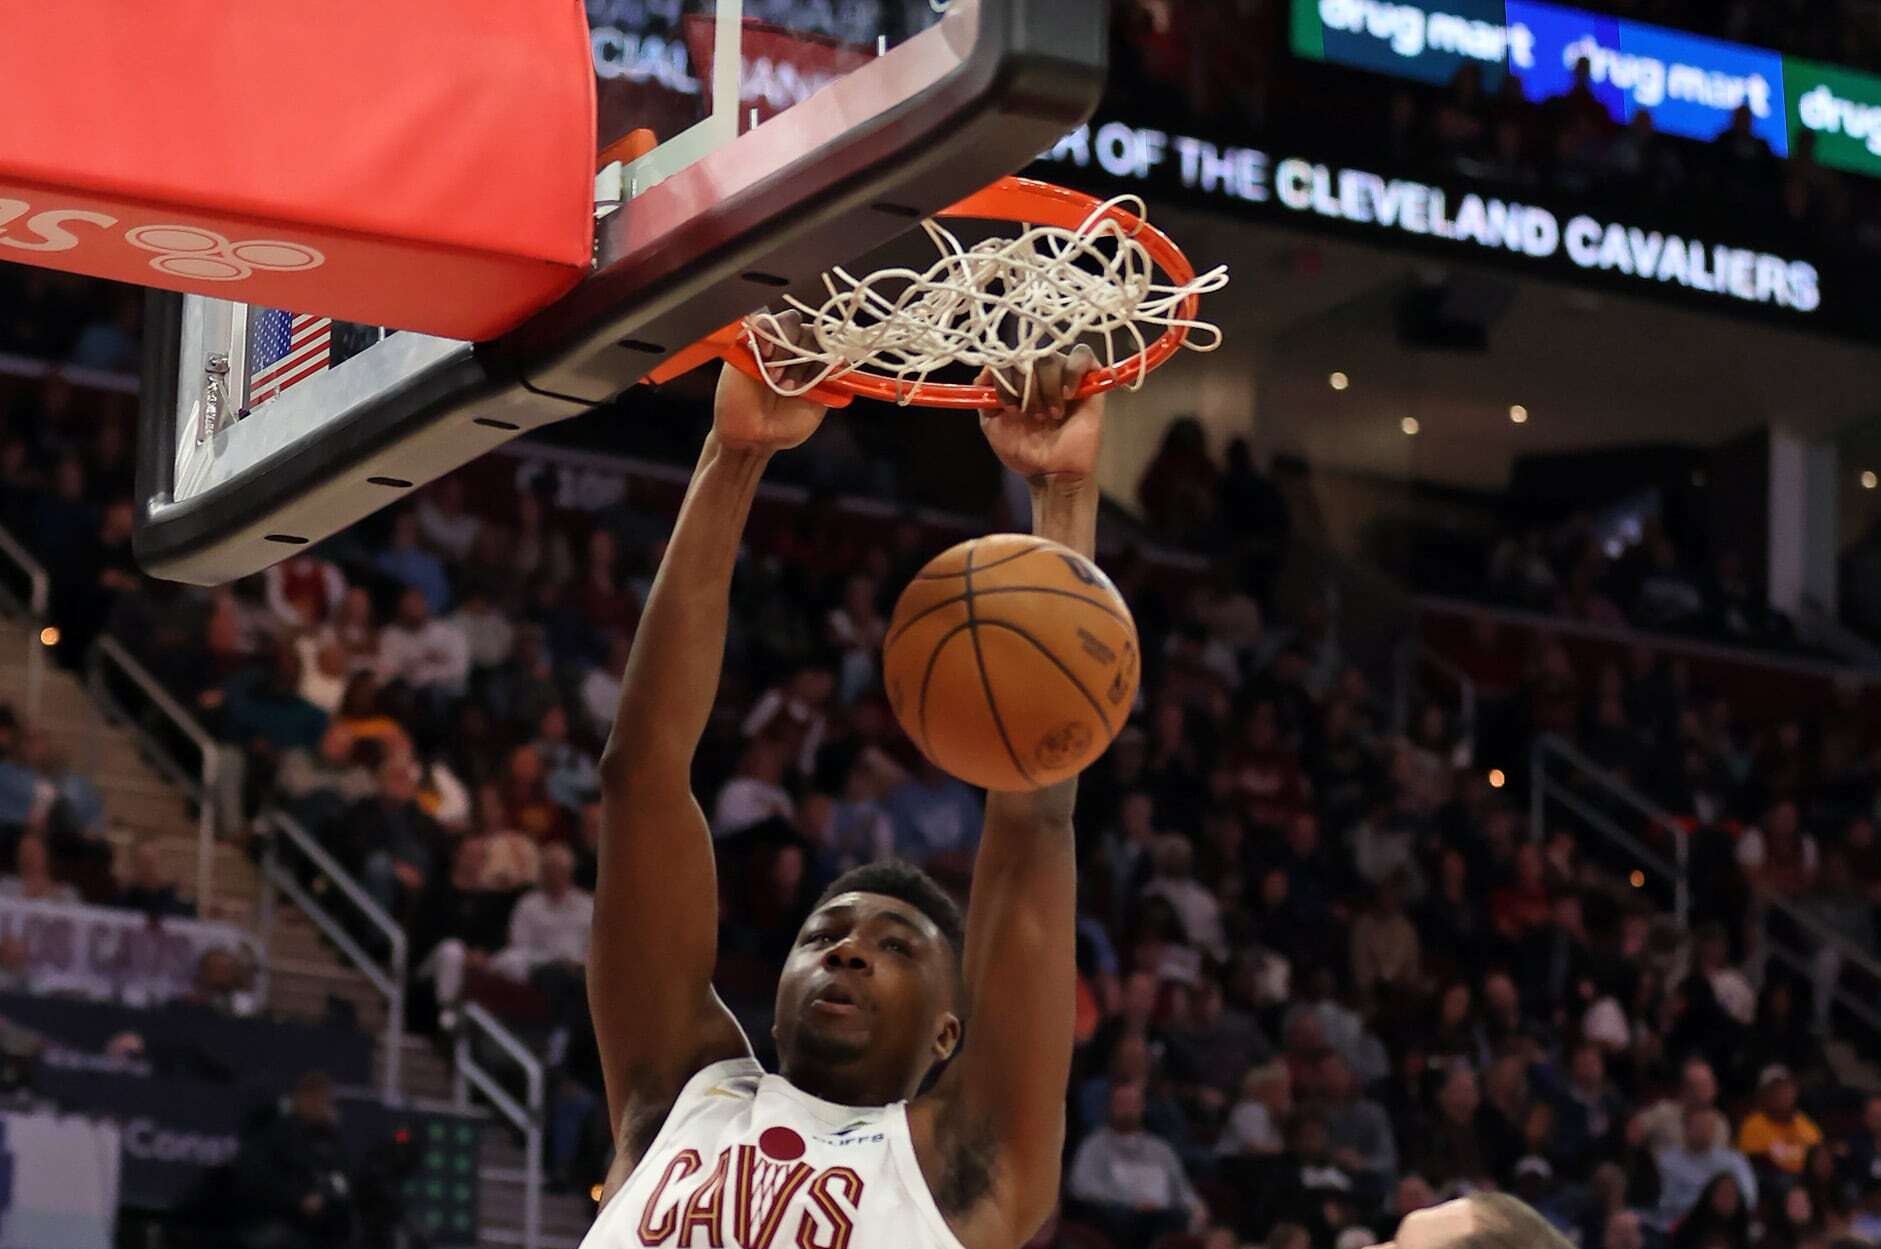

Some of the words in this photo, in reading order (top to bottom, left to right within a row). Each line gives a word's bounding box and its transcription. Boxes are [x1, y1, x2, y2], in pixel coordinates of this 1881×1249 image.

[1095, 121, 1168, 179] OF
[1174, 135, 1271, 202] THE
[1275, 157, 1560, 258] CLEVELAND
[1565, 213, 1820, 313] CAVALIERS
